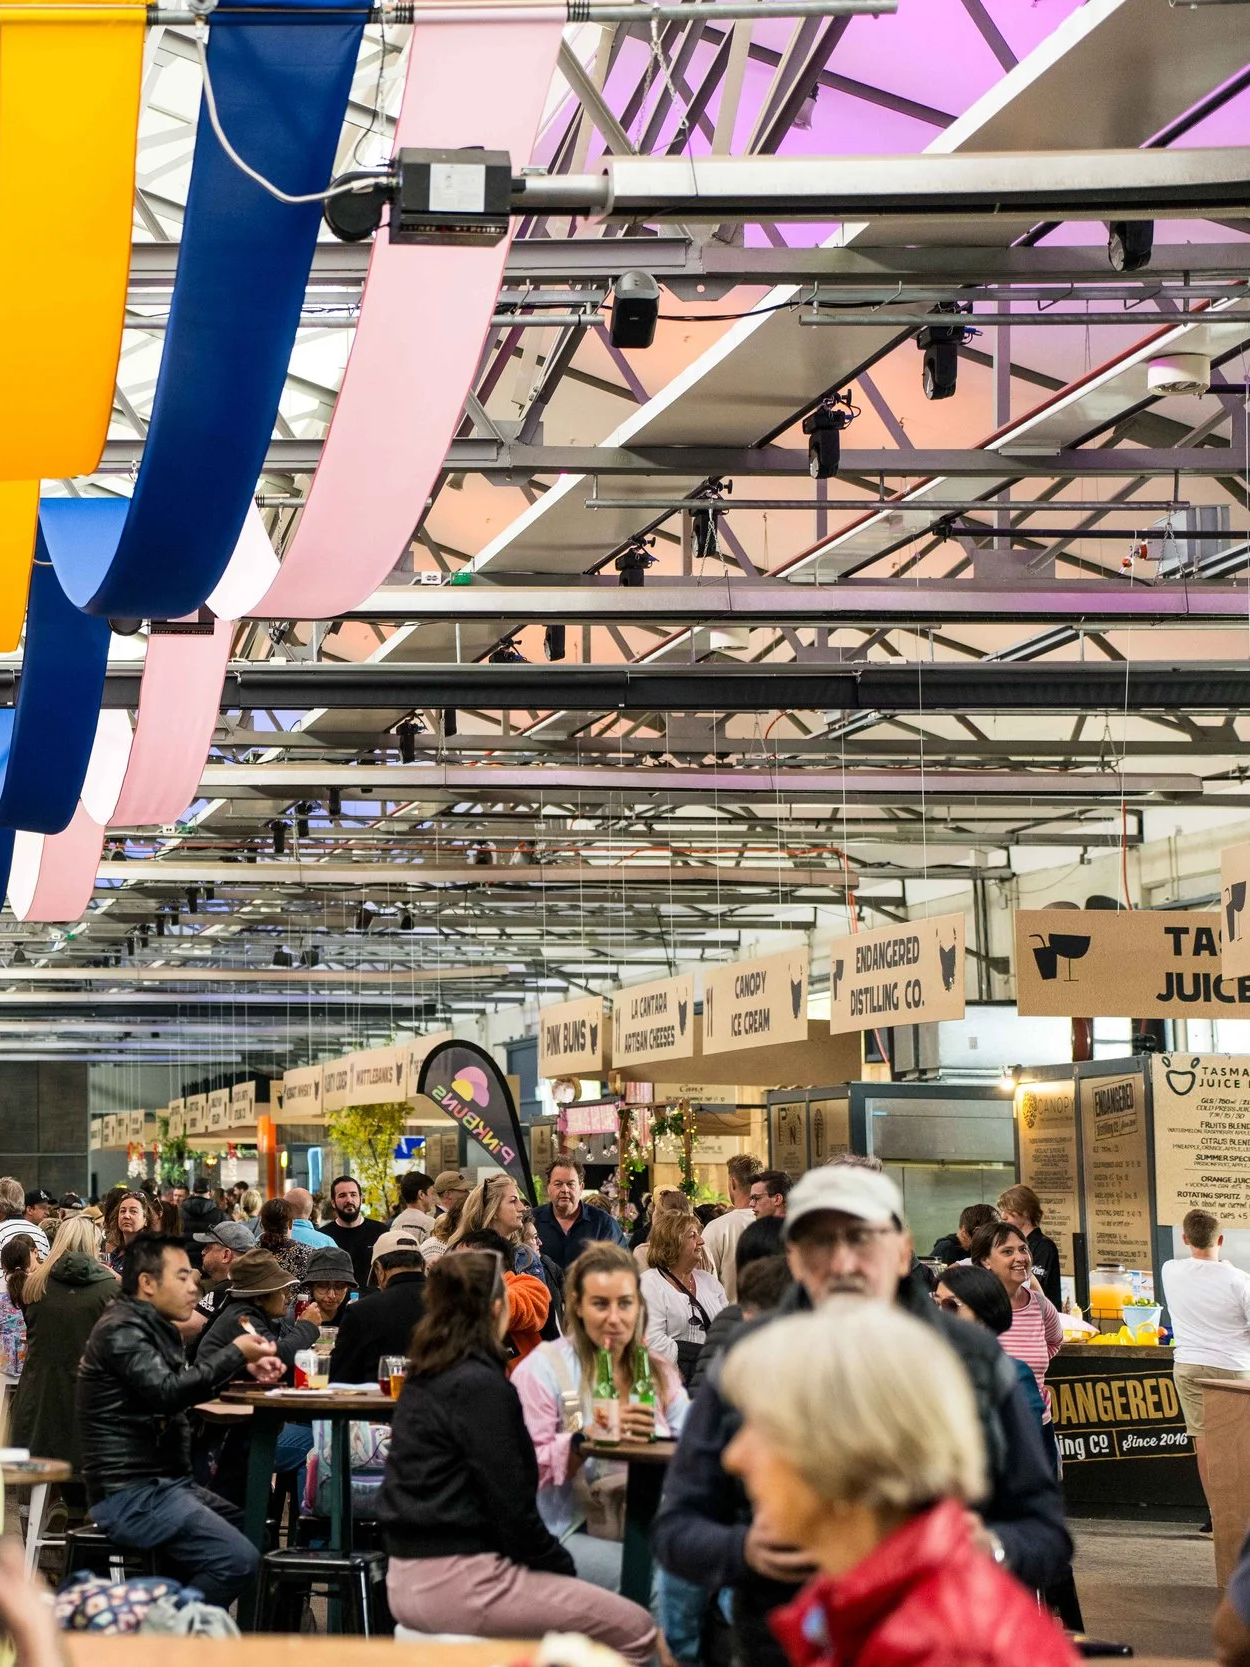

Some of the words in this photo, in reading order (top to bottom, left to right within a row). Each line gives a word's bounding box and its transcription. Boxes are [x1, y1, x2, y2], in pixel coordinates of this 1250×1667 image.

[855, 935, 920, 974] ENDANGERED
[1164, 926, 1222, 957] TA
[734, 970, 767, 999] CANOPY
[850, 982, 899, 1017] DISTILLING
[904, 979, 925, 1010] CO.
[631, 999, 639, 1020] LA
[639, 991, 668, 1019] CANTARA
[731, 1013, 742, 1037] ICE
[743, 1007, 770, 1035] CREAM
[546, 1023, 561, 1057] PINK
[563, 1019, 587, 1054] BUNS
[624, 1030, 648, 1054] ARTISAN
[649, 1025, 675, 1050] CHEESES
[1199, 1078, 1241, 1089] JUICE
[1200, 1121, 1227, 1129] FRUITS
[1200, 1137, 1228, 1146] CITRUS
[1195, 1153, 1229, 1162] SUMMER
[1200, 1175, 1233, 1183] ORANGE
[1176, 1190, 1214, 1199] ROTATING
[1122, 1434, 1158, 1451] Since
[1159, 1432, 1188, 1447] 2016
